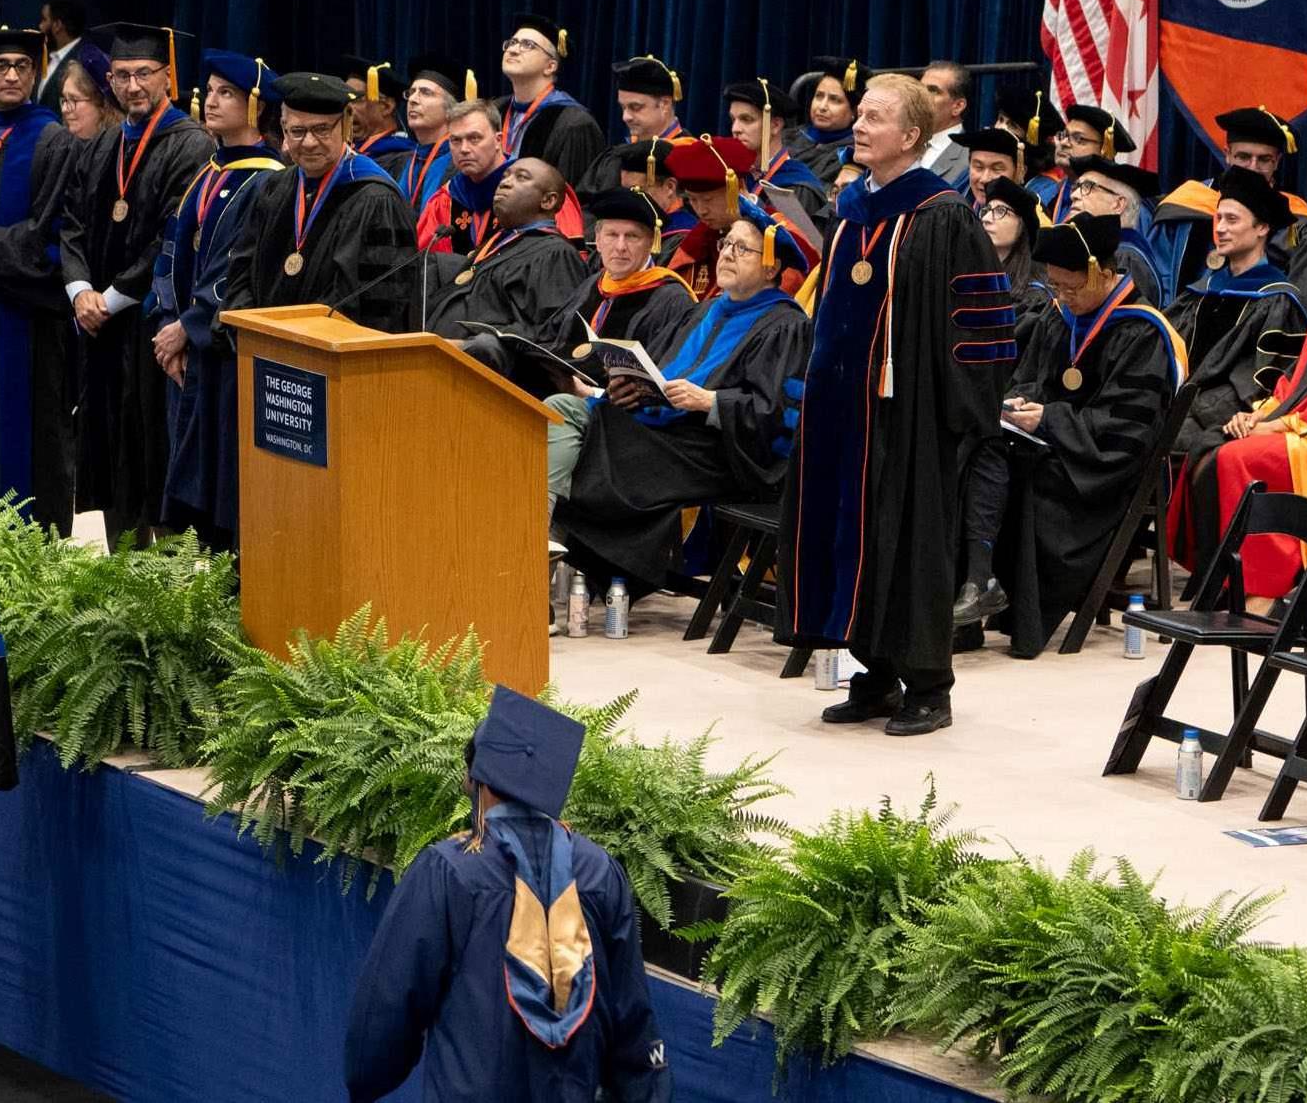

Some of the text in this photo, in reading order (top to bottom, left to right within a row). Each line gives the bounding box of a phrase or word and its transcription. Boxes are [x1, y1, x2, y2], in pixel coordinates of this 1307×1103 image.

[265, 375, 312, 400] THE GEORGE
[265, 391, 312, 416] WASHINGTON
[265, 407, 312, 432] UNIVERSITY
[304, 444, 313, 455] DC
